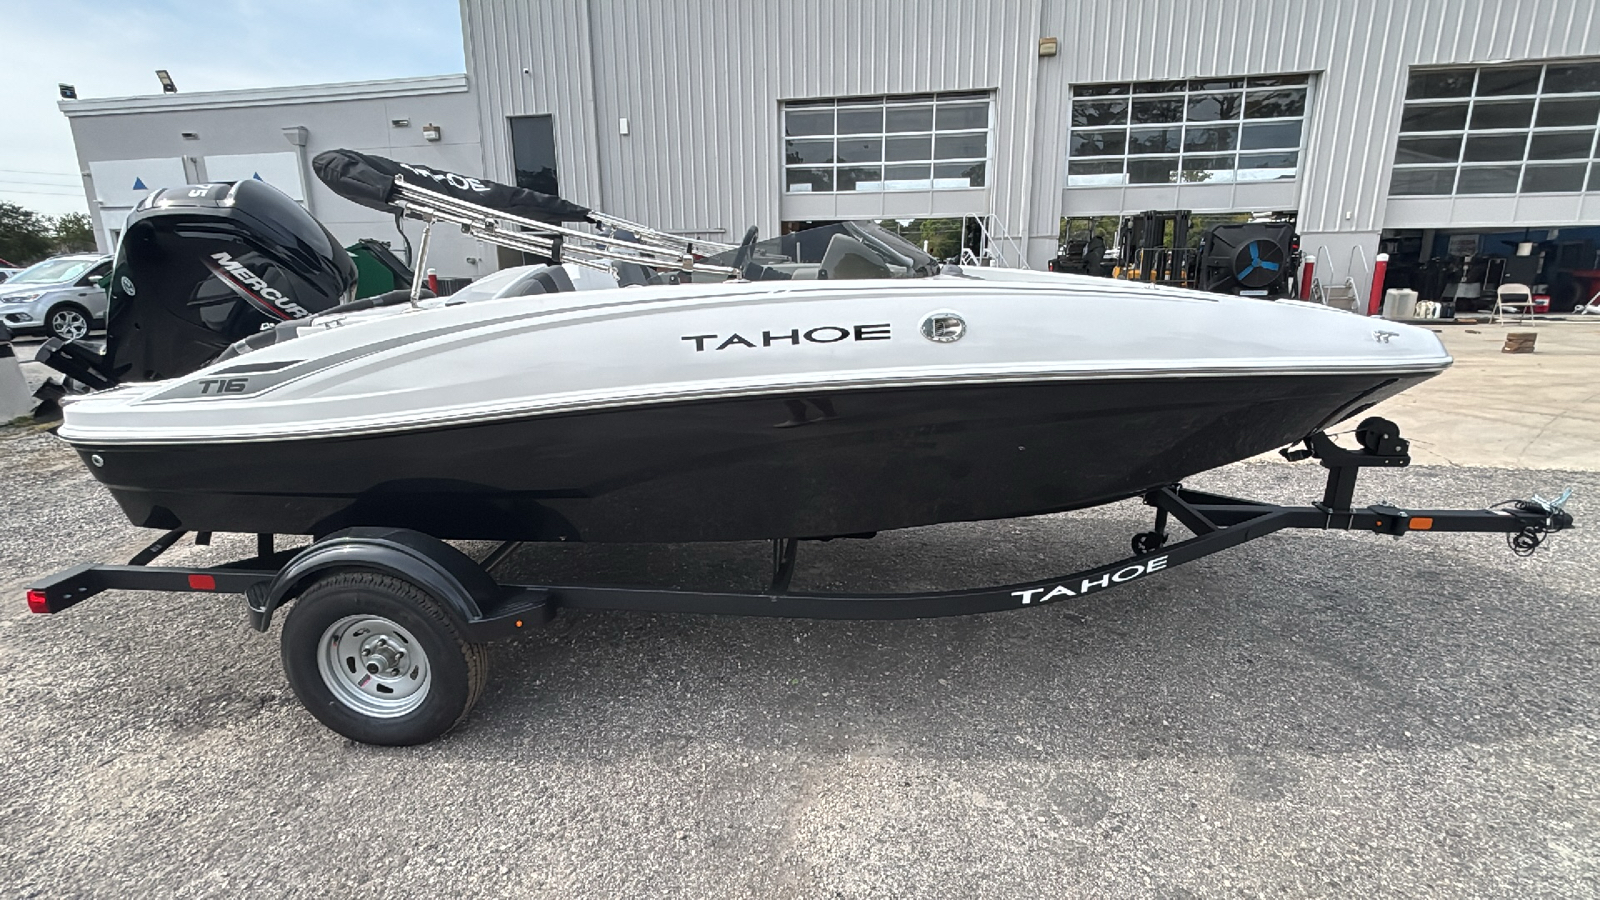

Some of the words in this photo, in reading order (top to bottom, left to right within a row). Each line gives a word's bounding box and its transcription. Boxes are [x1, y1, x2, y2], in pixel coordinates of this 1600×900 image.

[210, 252, 313, 319] MERCUR
[681, 323, 891, 352] TAHOE
[199, 378, 248, 394] T16
[1011, 555, 1169, 604] TAHOE
